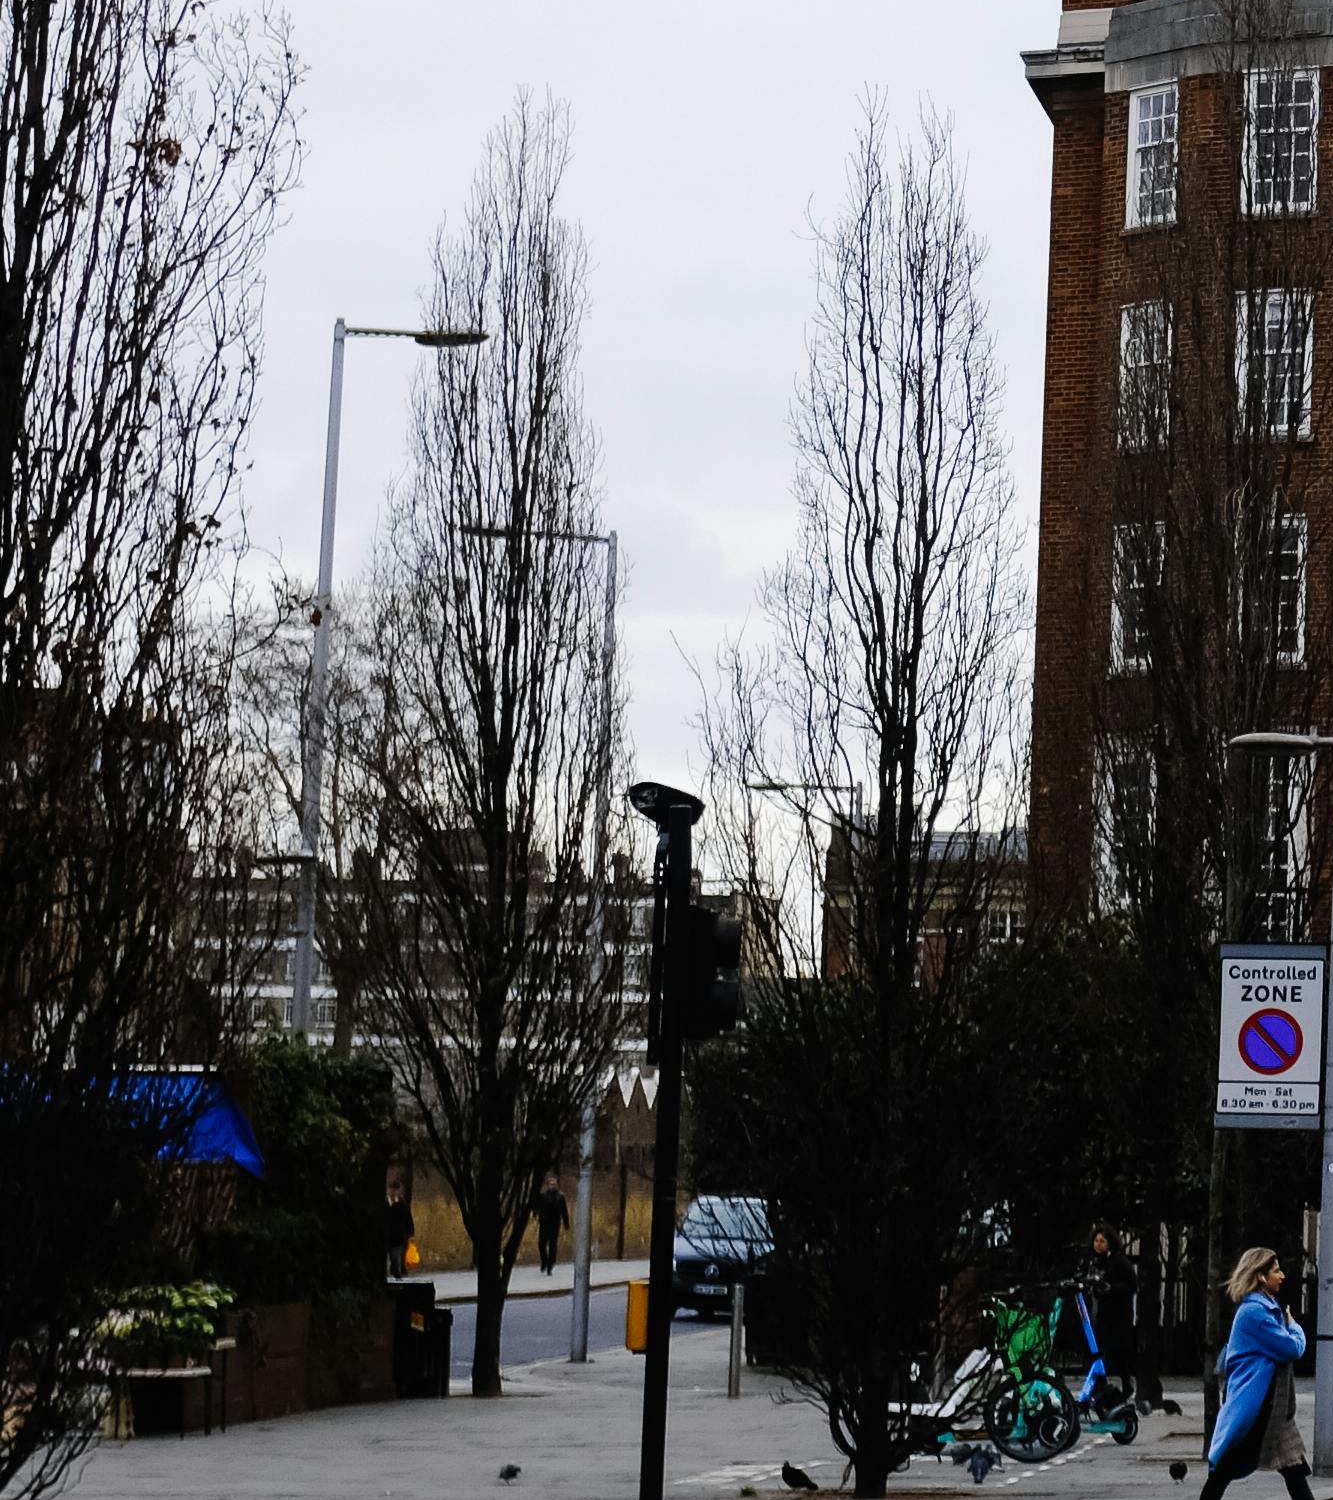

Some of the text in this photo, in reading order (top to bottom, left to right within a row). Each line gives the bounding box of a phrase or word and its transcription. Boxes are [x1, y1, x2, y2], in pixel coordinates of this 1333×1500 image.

[1229, 965, 1317, 980] Controlled
[1241, 985, 1303, 1002] ZONE
[1244, 1086, 1267, 1096] Mon
[1275, 1086, 1293, 1097] Sat
[1221, 1099, 1247, 1108] 8.30
[1248, 1101, 1264, 1109] am
[1272, 1100, 1297, 1109] 6.30
[1299, 1102, 1315, 1110] pm
